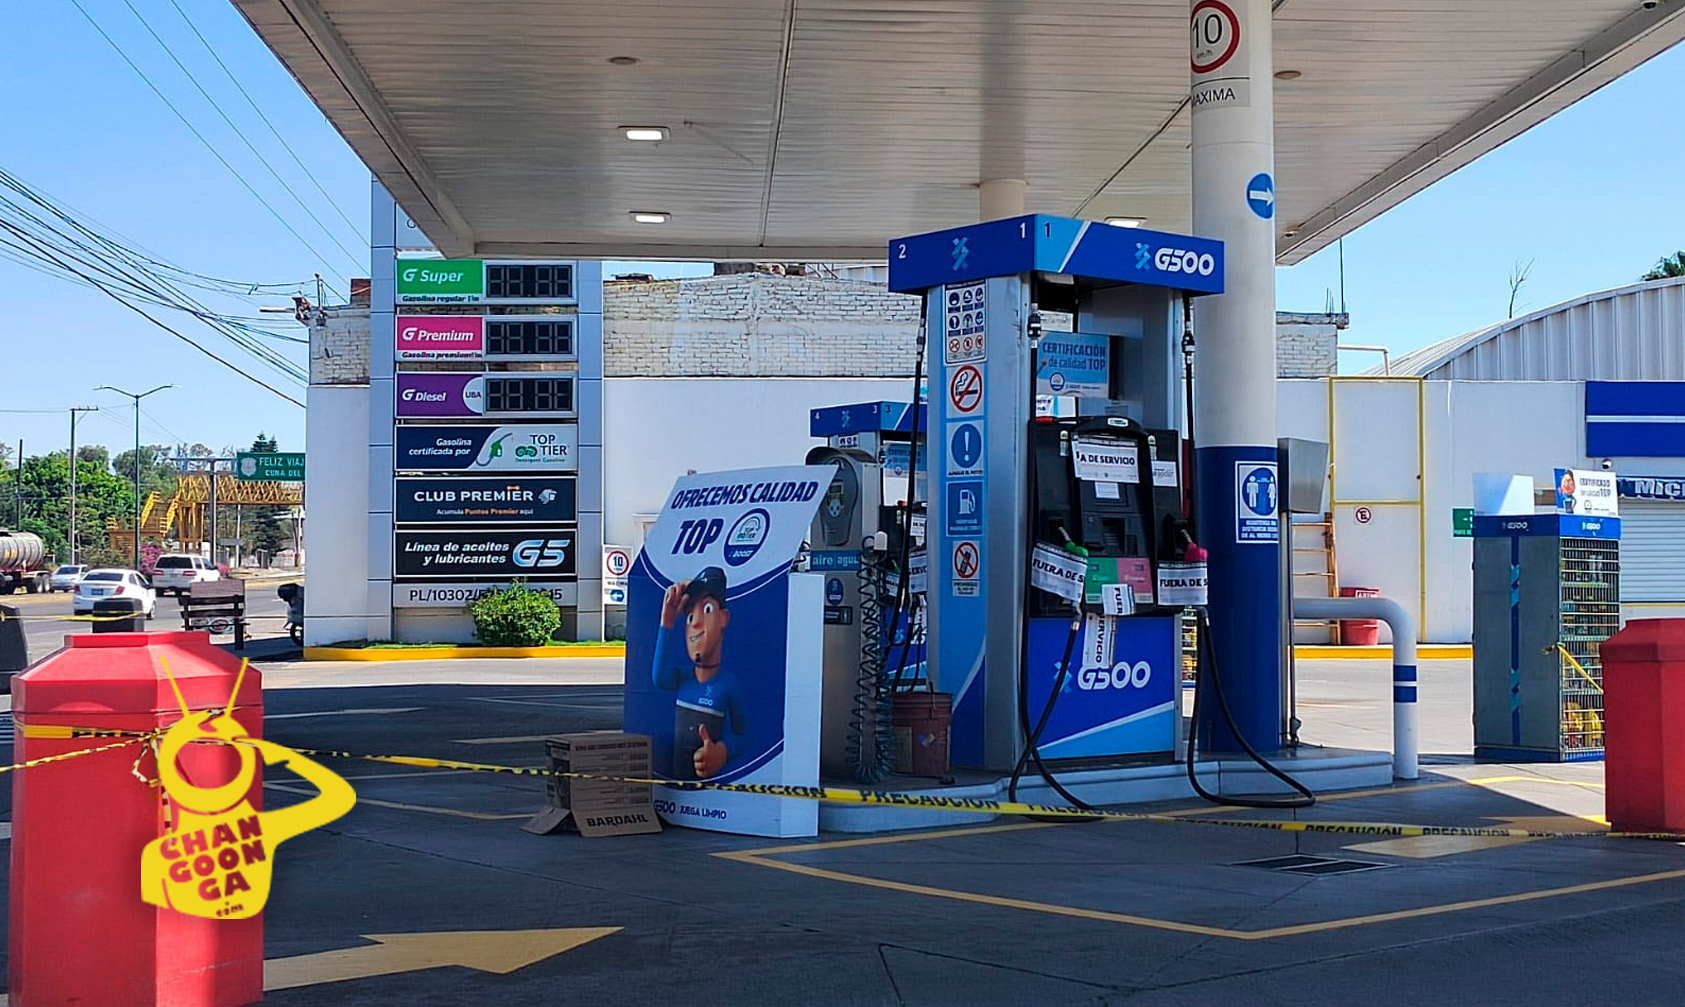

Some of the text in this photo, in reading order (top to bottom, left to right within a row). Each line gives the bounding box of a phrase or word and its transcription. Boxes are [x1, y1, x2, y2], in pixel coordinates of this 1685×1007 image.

[1192, 14, 1222, 48] 10
[1019, 222, 1026, 239] 1
[1043, 222, 1050, 238] 1
[898, 244, 906, 259] 2
[1155, 248, 1214, 275] G500
[420, 270, 464, 285] Super
[402, 295, 436, 303] Gasolina
[418, 330, 474, 342] Premium
[402, 351, 435, 359] Gasolina
[1042, 341, 1106, 358] CERTIFICACIÓN
[1048, 356, 1106, 371] de calidad TOP
[415, 392, 447, 402] Diesel
[436, 438, 472, 446] Gasolina
[529, 434, 556, 445] TOP
[408, 447, 471, 457] certificada por
[540, 445, 567, 456] TIER
[259, 457, 283, 467] FELIZ
[1088, 455, 1098, 464] DE
[1099, 455, 1136, 466] SERVICIO
[414, 489, 534, 502] CLUB PREMIER
[671, 481, 819, 510] OFRECEMOS CALIDAD
[671, 518, 724, 555] TOP
[405, 542, 510, 552] Línea de aceites
[422, 554, 506, 567] y lubricantes
[613, 556, 624, 567] 10
[813, 554, 833, 565] aire
[1033, 558, 1064, 577] FUERA
[1065, 570, 1077, 581] DE
[1160, 578, 1187, 588] FUERA
[1189, 578, 1202, 587] DE
[1078, 661, 1151, 690] G500
[680, 805, 701, 817] JUEGA
[702, 808, 727, 820] LIMPIO
[586, 813, 648, 828] BARDAHL
